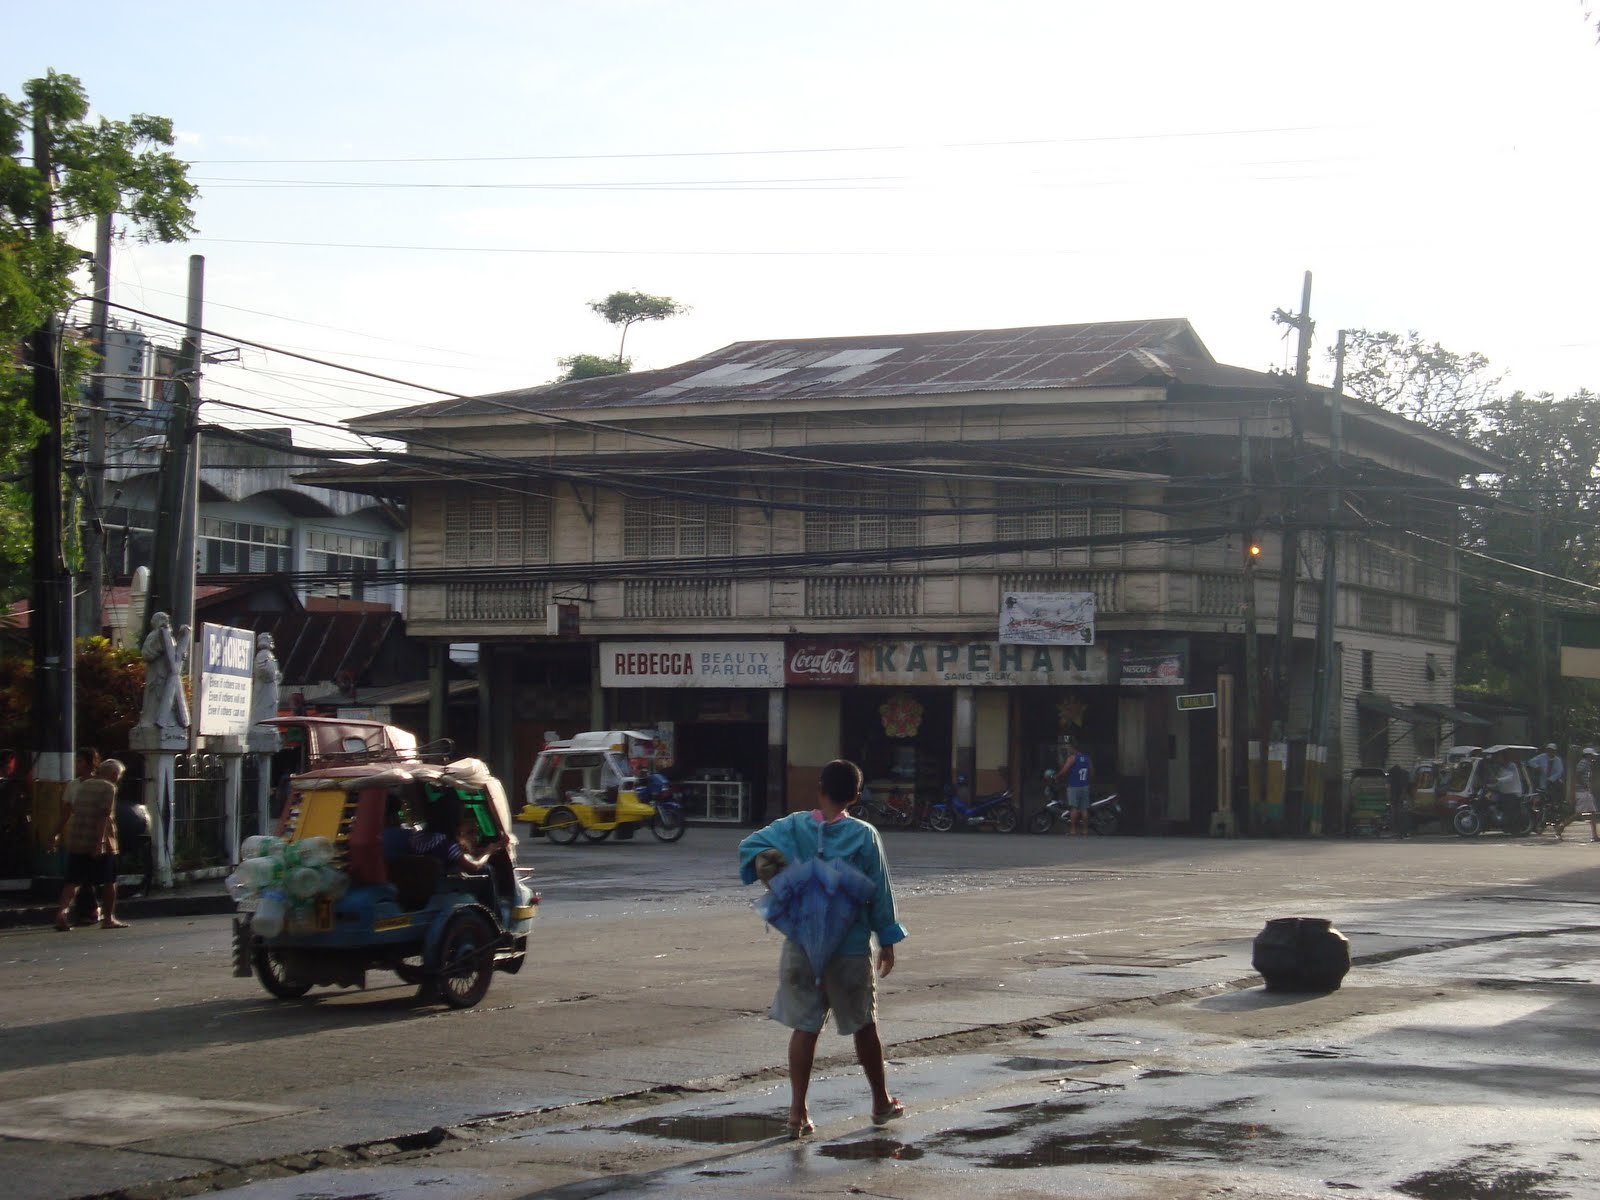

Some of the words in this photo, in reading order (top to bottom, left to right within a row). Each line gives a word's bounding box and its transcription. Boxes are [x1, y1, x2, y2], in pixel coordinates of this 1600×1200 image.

[209, 634, 221, 666] Be
[222, 636, 250, 671] HONEST
[875, 644, 1087, 672] KAPEHAN
[614, 653, 694, 676] REBECCA
[701, 653, 769, 664] BEAUTY
[701, 664, 769, 675] PARLOR
[1078, 767, 1087, 781] 17
